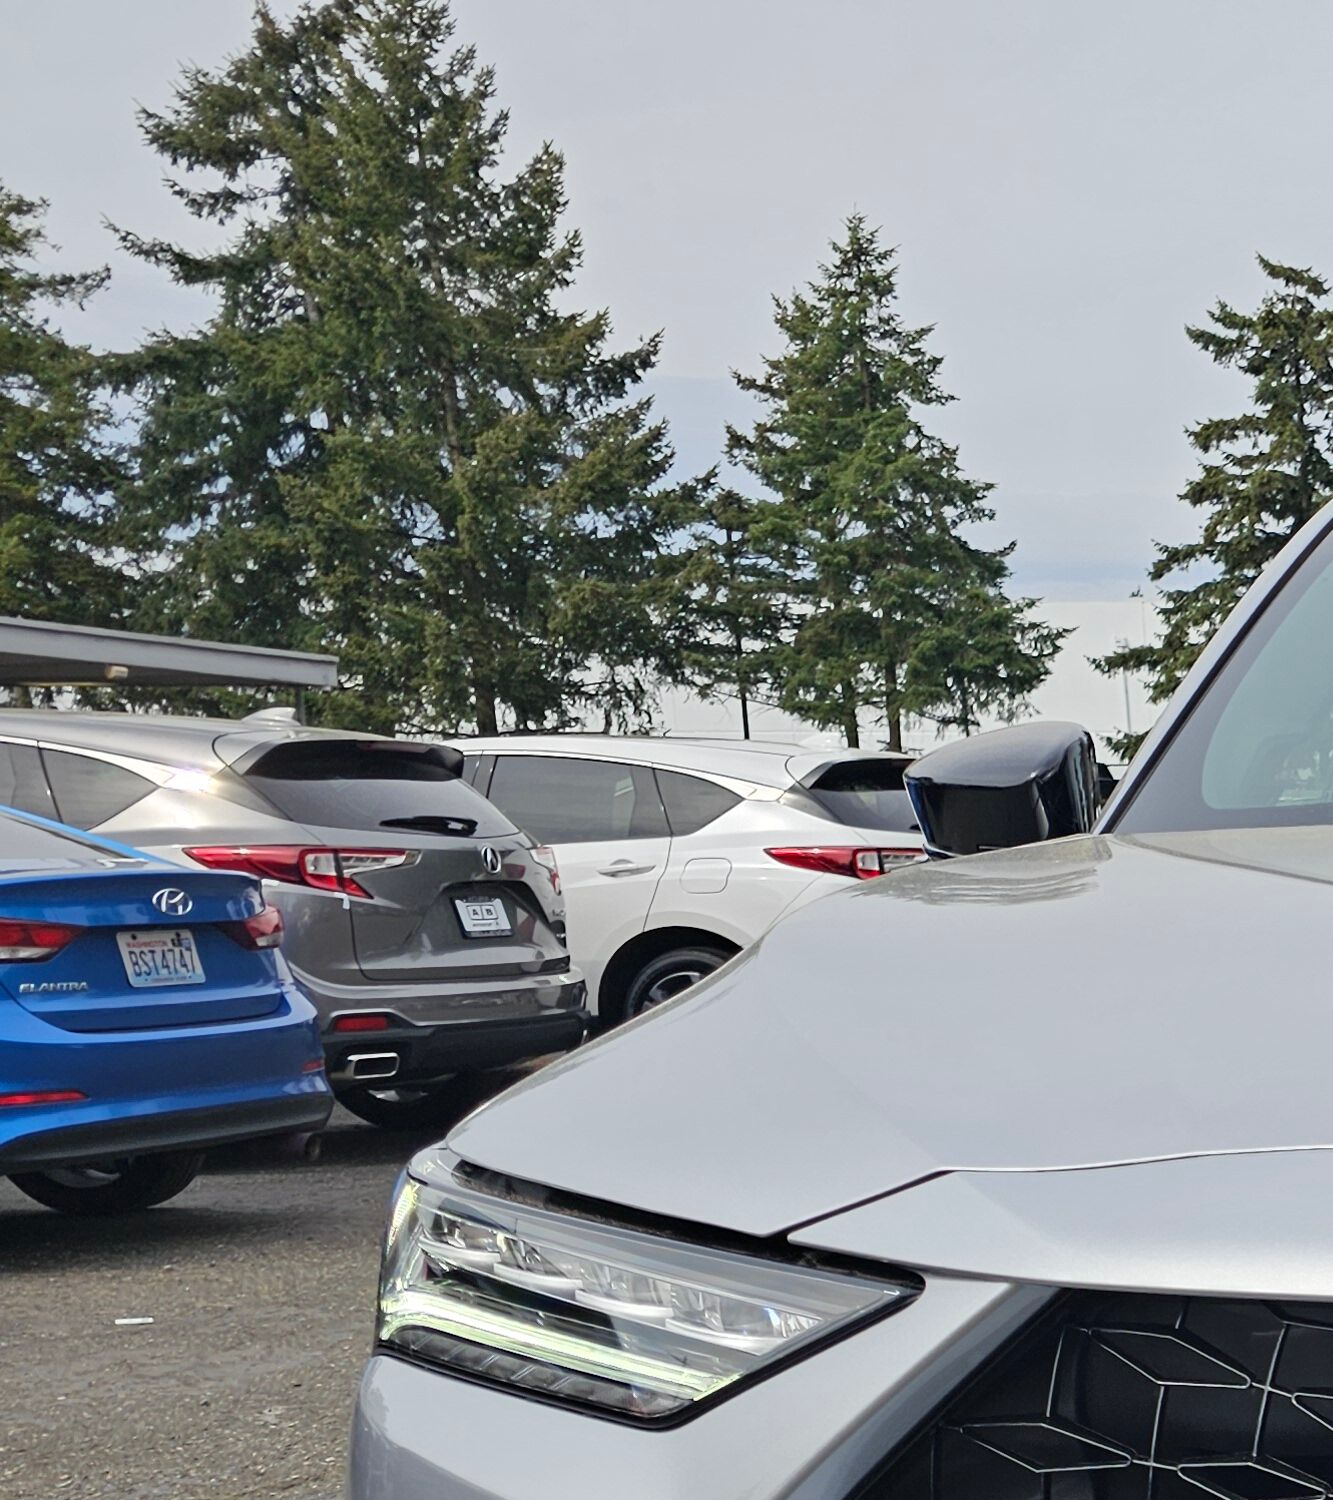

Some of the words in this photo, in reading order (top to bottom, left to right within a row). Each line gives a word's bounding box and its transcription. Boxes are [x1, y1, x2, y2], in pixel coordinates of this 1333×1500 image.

[472, 908, 480, 917] A
[485, 908, 494, 917] B
[127, 948, 196, 978] BST4747
[19, 981, 88, 993] ELANTRA
